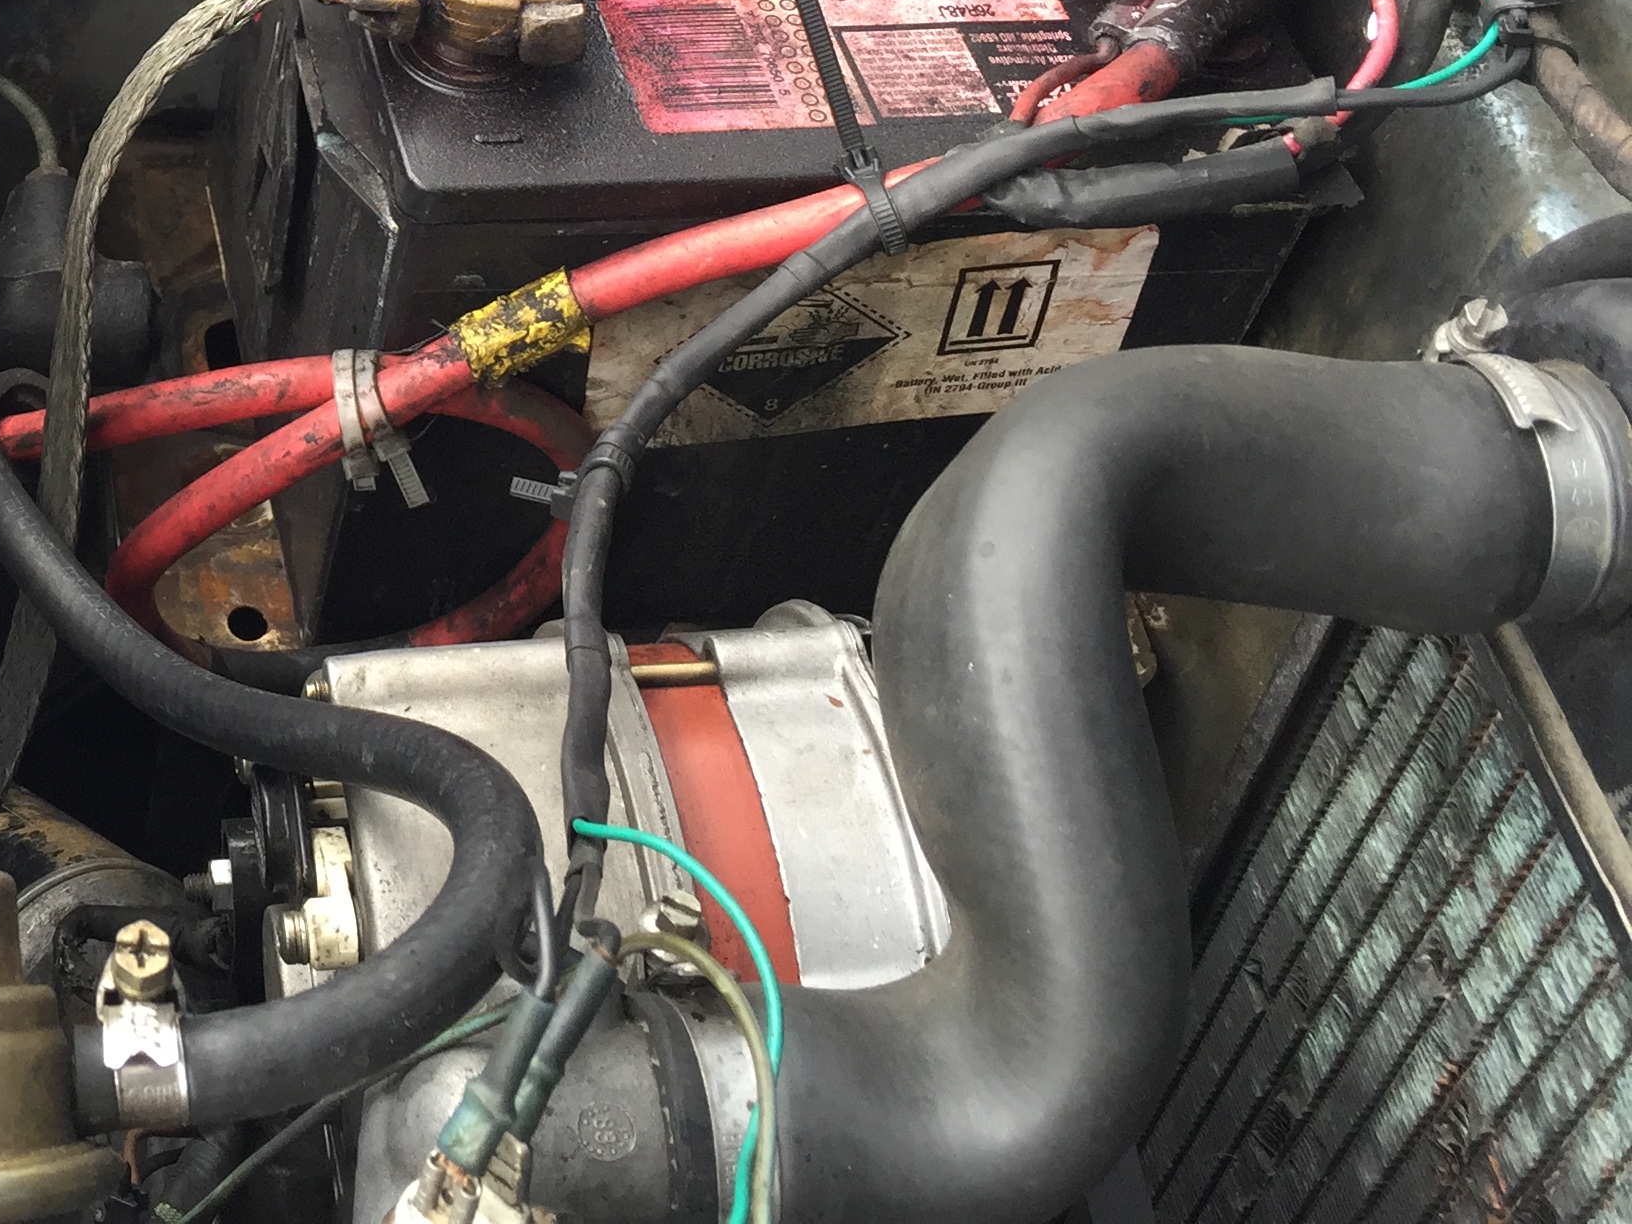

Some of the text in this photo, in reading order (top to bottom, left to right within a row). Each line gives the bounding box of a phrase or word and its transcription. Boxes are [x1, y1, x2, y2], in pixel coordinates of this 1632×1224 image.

[937, 3, 995, 18] 26R48J
[999, 33, 1016, 42] MO
[996, 44, 1058, 53] Distributors
[988, 54, 1046, 65] Automotive
[718, 344, 844, 372] CORROSIVE
[972, 370, 1005, 380] Filled
[1008, 367, 1032, 377] with
[925, 385, 941, 395] UN
[764, 398, 779, 411] 8
[1, 488, 33, 531] FUEL
